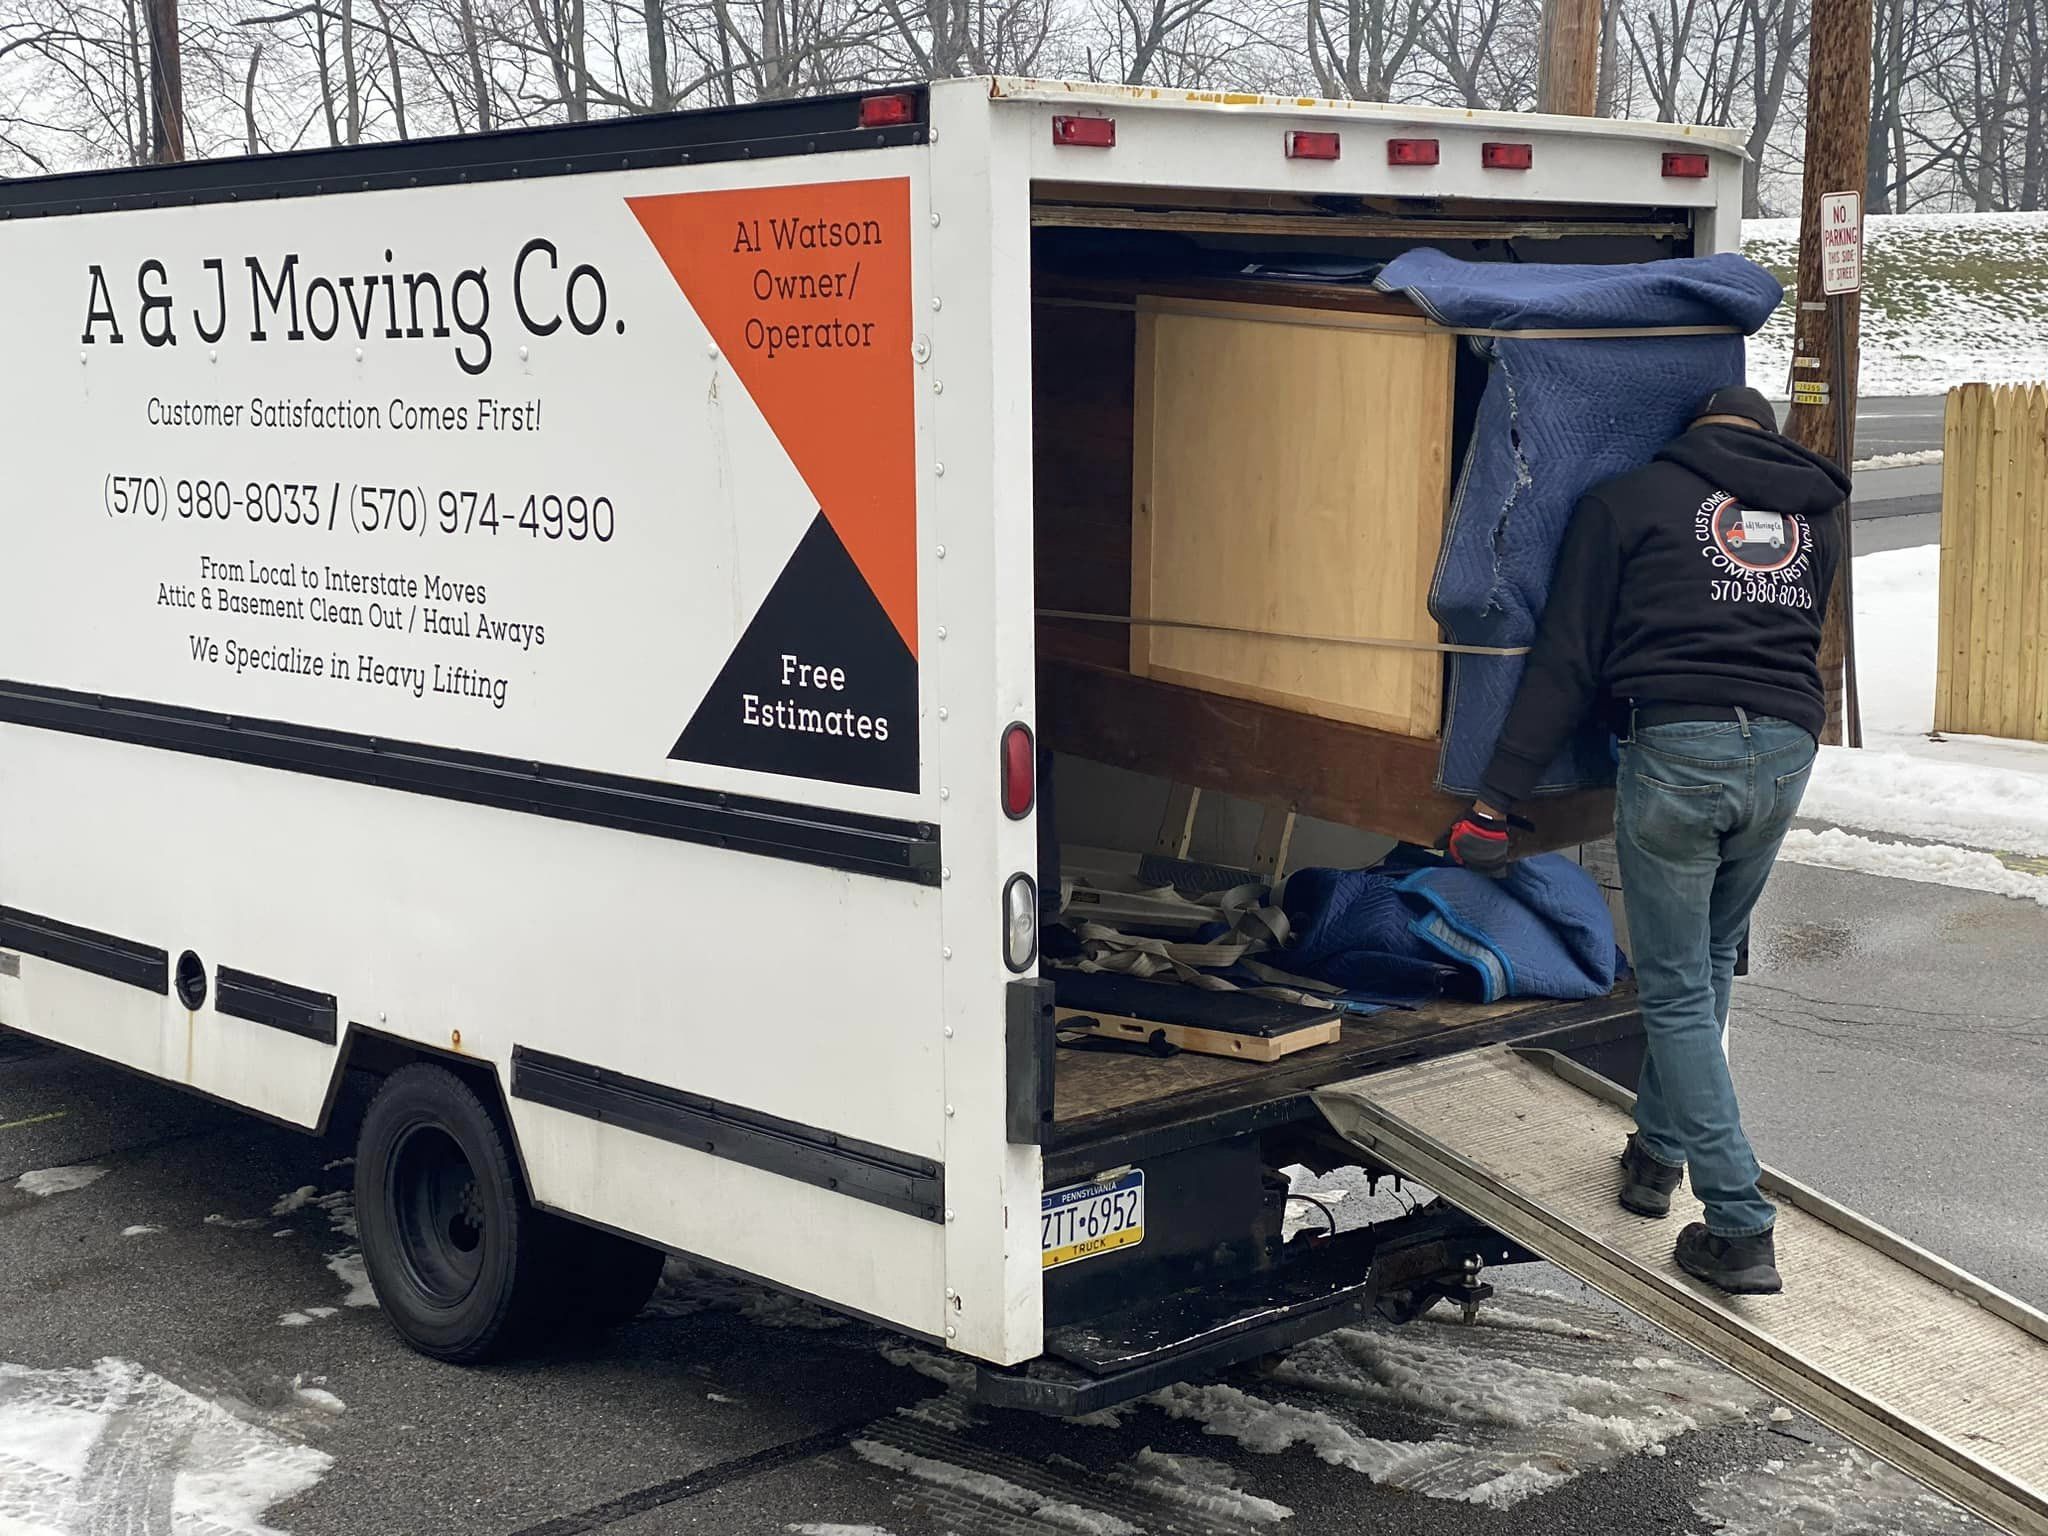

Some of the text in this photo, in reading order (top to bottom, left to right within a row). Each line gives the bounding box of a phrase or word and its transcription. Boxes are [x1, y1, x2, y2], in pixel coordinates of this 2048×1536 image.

[1832, 205, 1847, 225] NO
[733, 217, 882, 253] Al Watson
[1825, 226, 1857, 247] PARKING
[1828, 249, 1855, 265] THIS SIDE
[1828, 266, 1856, 281] OF STREET
[753, 261, 860, 301] Owner/
[81, 238, 625, 376] A & J Moving Co.
[745, 318, 875, 359] Operator
[147, 397, 541, 432] Customer Satisfaction Comes First!
[104, 473, 614, 543] (570) 980-8033 / (570) 974-4990
[1695, 490, 1731, 541] CUSTOME
[200, 555, 487, 605] From Local to Interstate Moves
[1702, 546, 1767, 584] COMES
[157, 582, 545, 652] Attic & Basement Clean Out / Haul Aways
[189, 635, 509, 710] We Specialize in Heavy Lifting
[781, 654, 846, 691] Free
[742, 694, 889, 741] Estimates
[1061, 1181, 1118, 1203] PENNSYLVANIA
[1072, 1238, 1107, 1256] TRUCK
